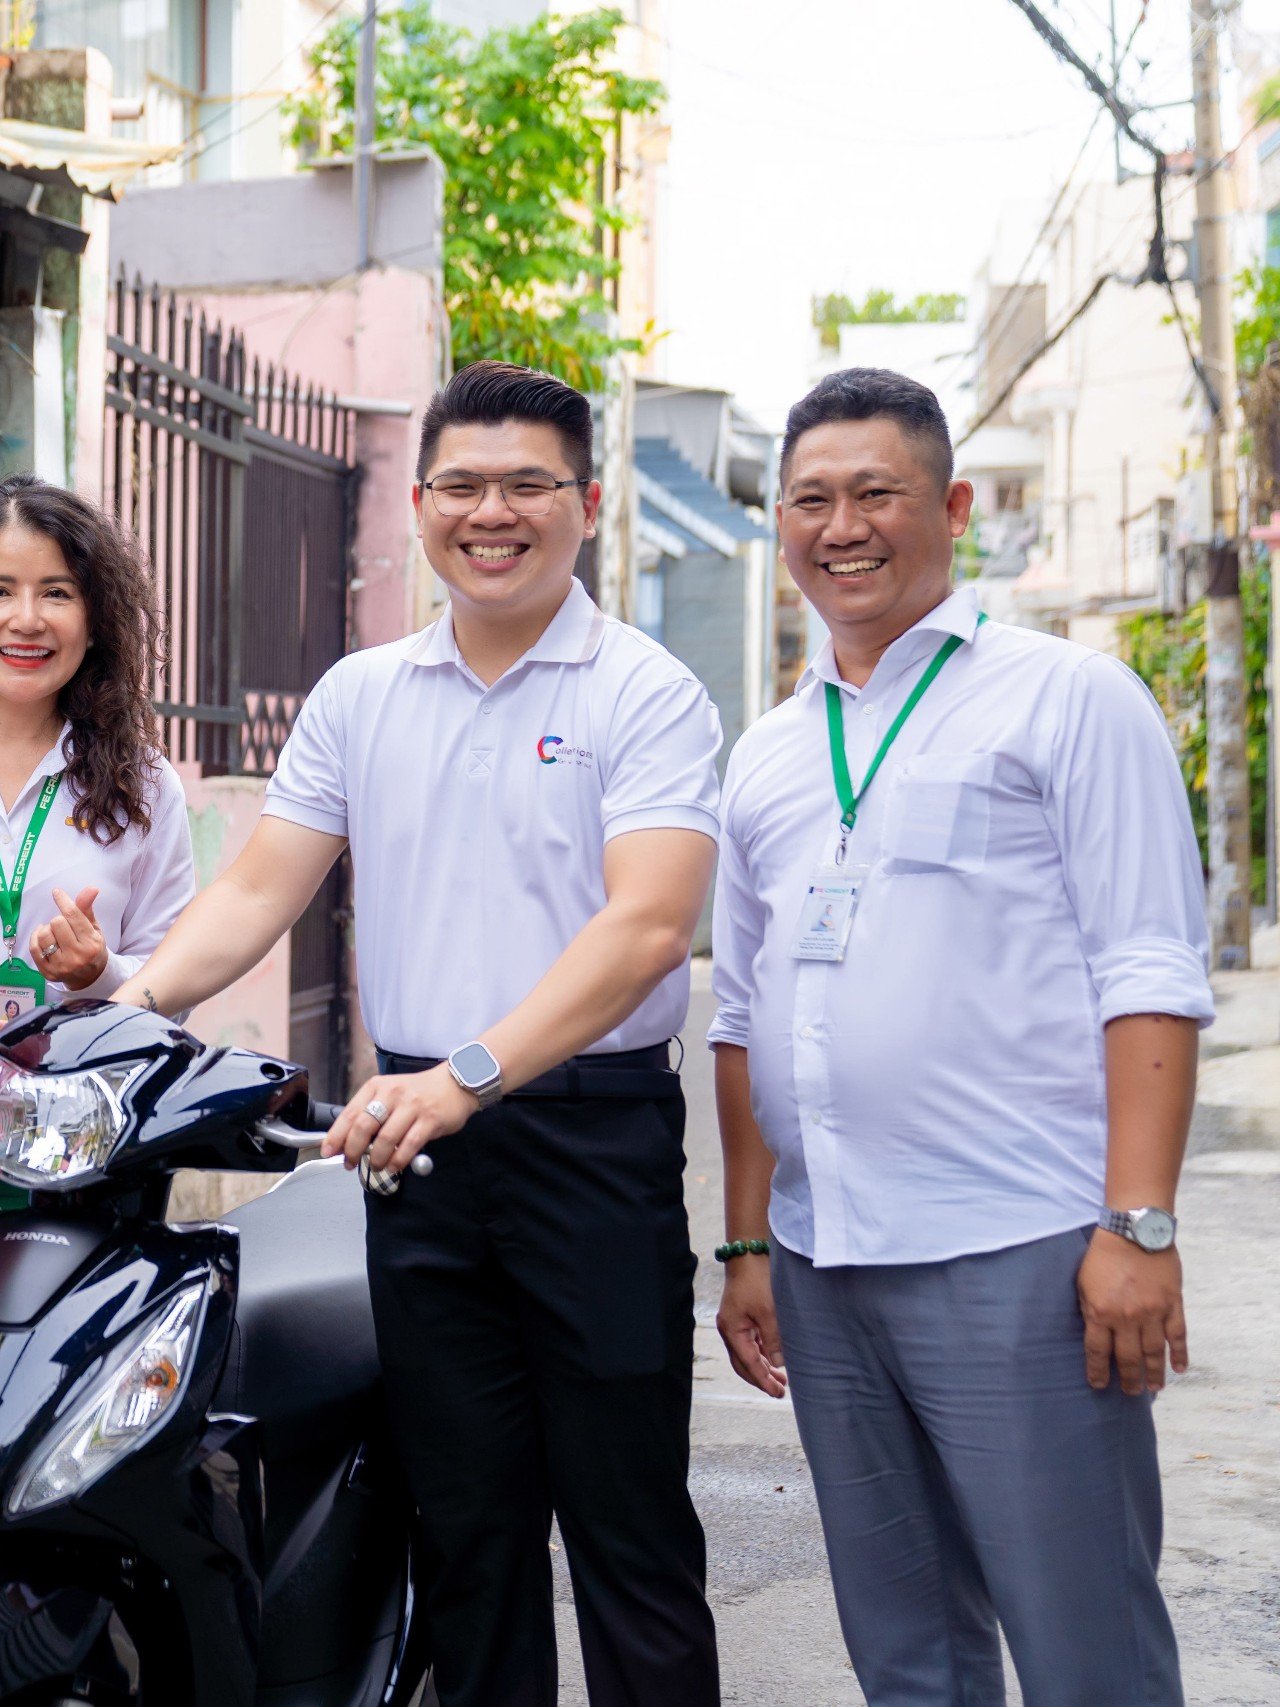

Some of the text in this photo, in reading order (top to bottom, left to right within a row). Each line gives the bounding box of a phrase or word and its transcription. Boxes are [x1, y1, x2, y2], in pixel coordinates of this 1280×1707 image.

[45, 773, 60, 795] CRE
[11, 831, 36, 892] FE CREDIT
[3, 1230, 71, 1247] HONDA
